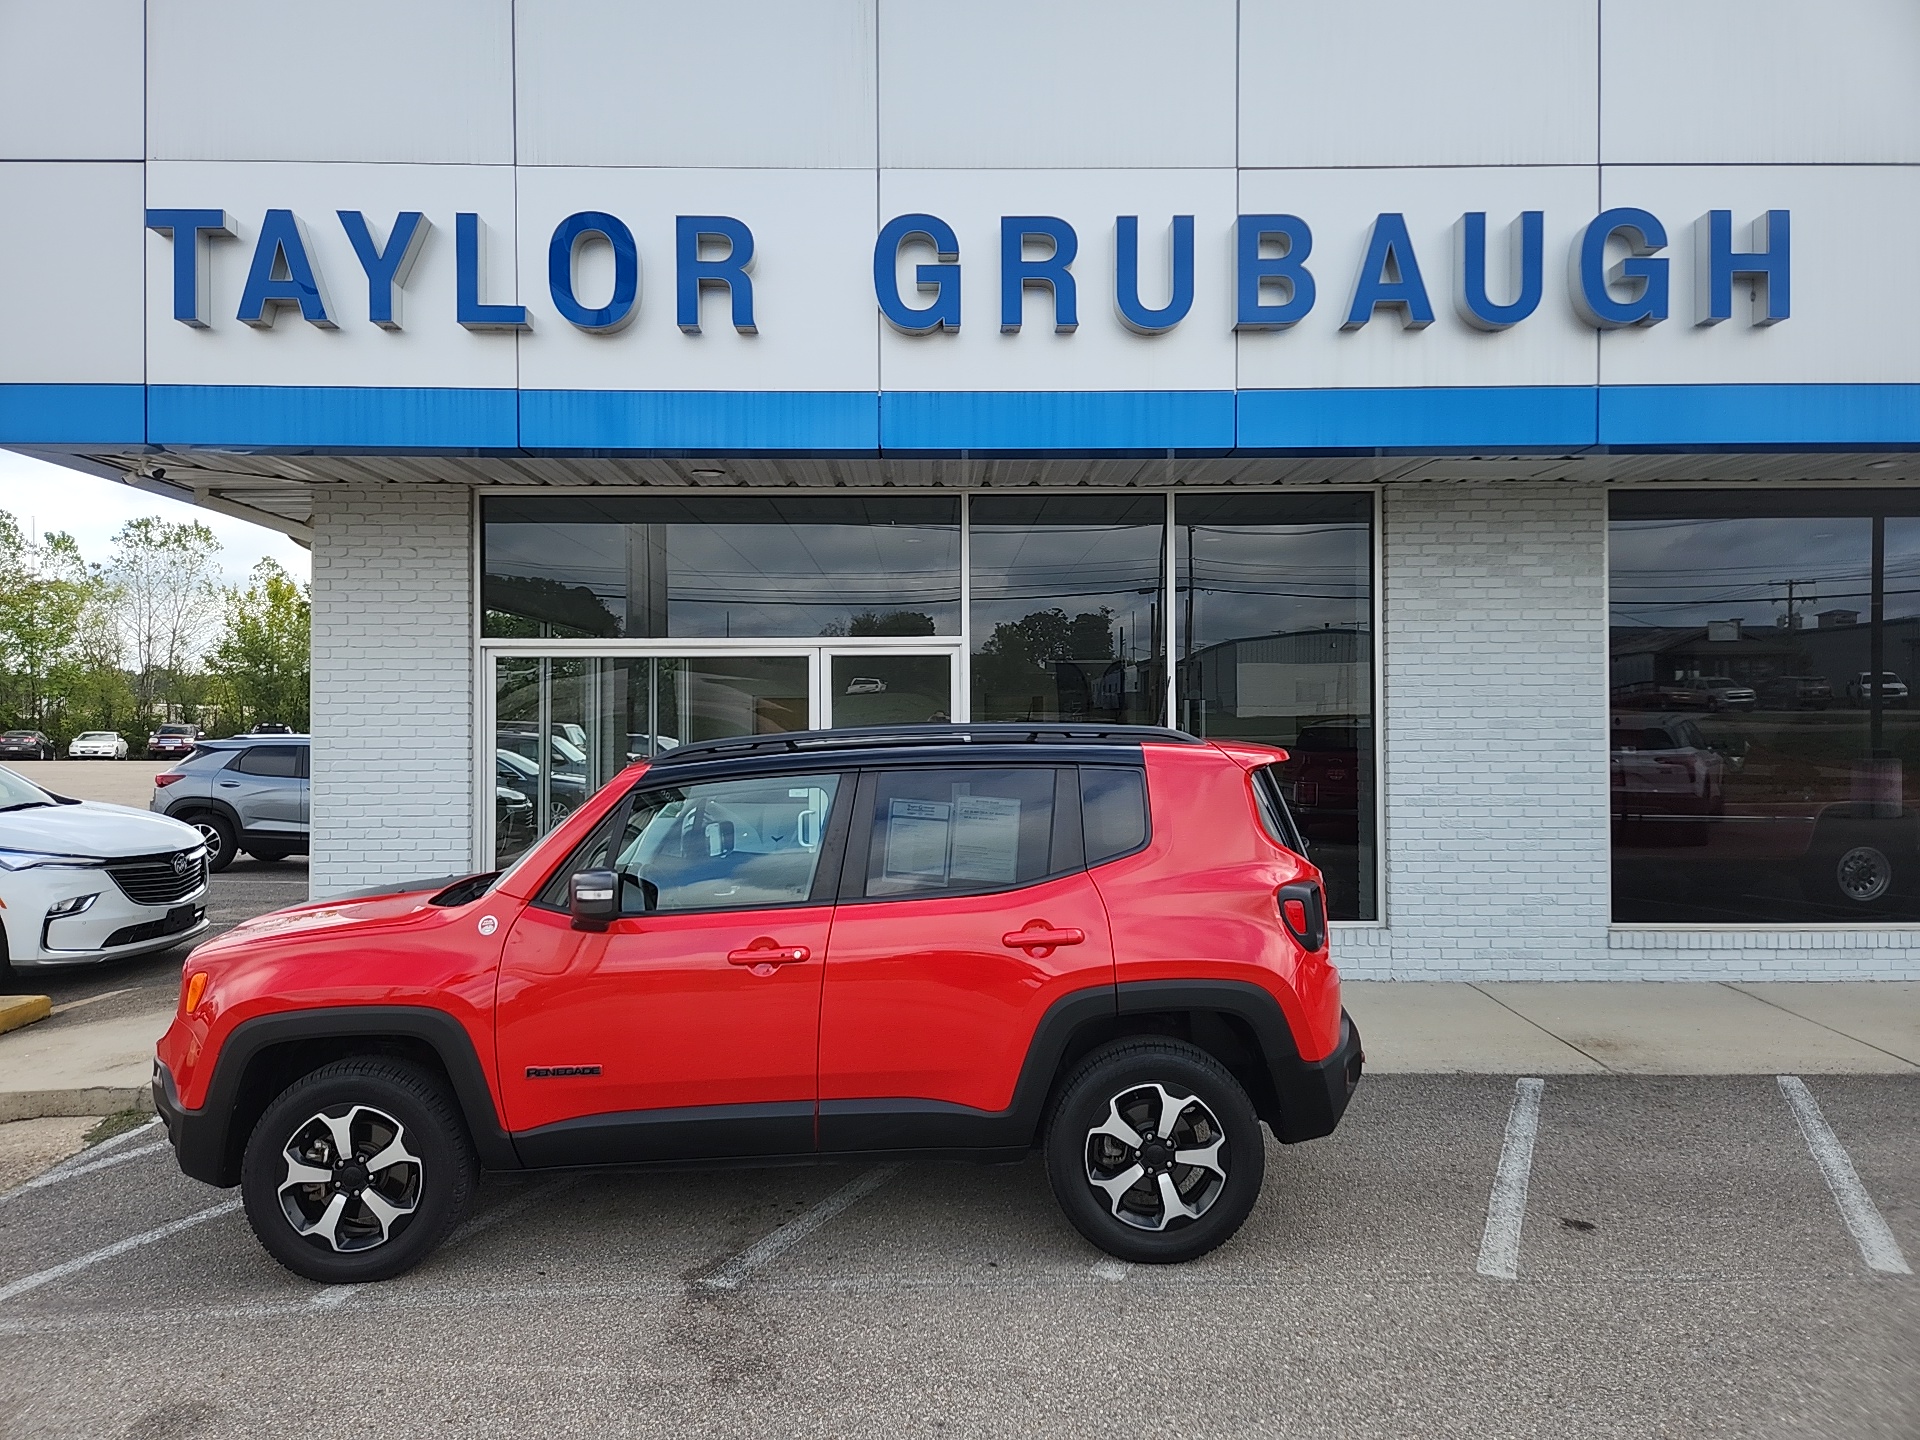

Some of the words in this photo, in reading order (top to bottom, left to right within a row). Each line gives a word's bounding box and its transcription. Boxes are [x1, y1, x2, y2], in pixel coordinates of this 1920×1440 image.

[146, 209, 758, 334] TAYLOR
[873, 207, 1791, 336] GRUBAUGH
[526, 1065, 602, 1078] RENEGADE
